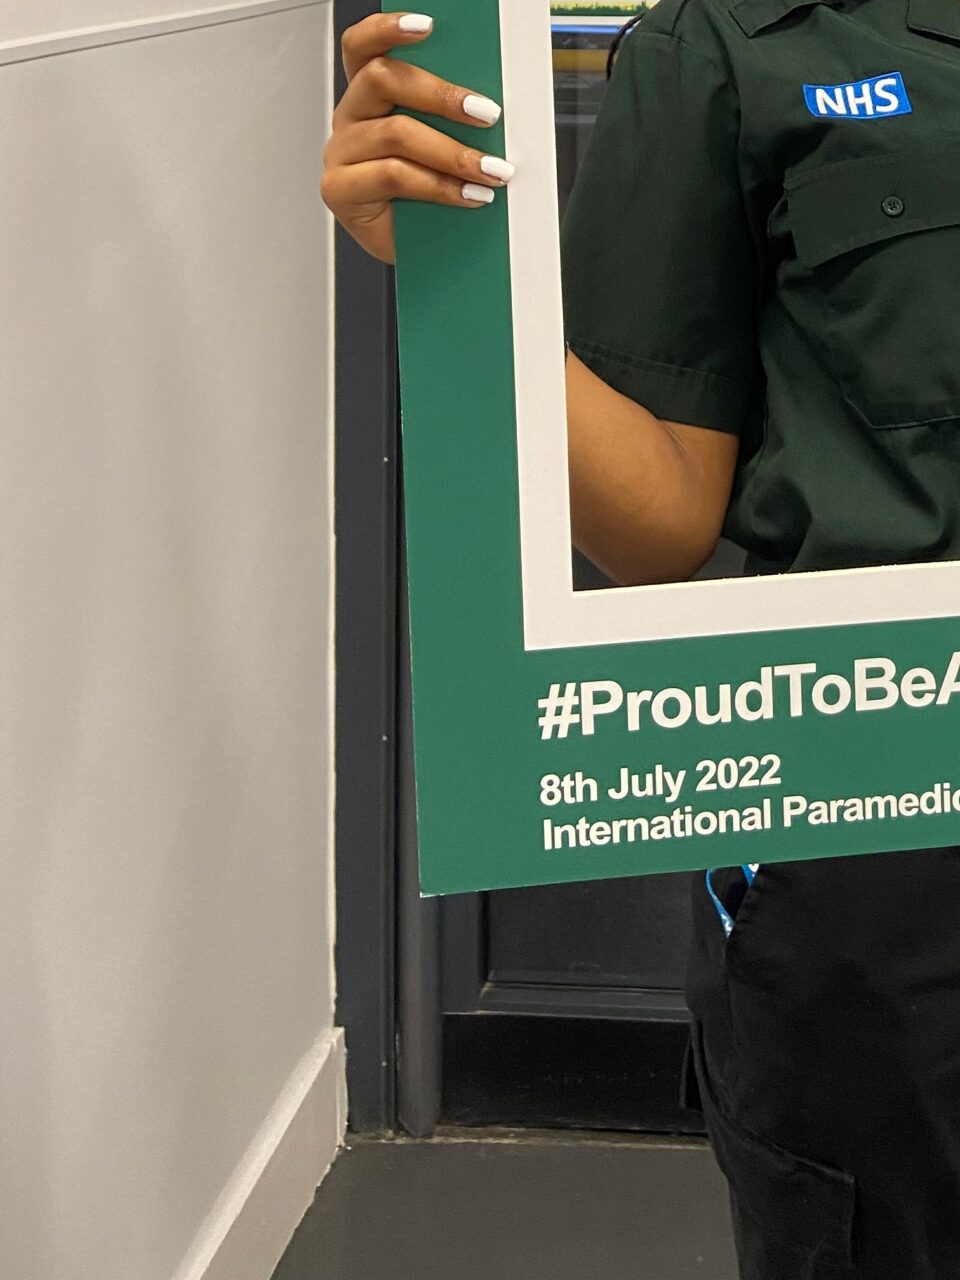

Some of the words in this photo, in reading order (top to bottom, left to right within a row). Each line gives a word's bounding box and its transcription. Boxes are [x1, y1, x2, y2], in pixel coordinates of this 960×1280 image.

[815, 78, 899, 115] NHS
[540, 771, 598, 806] 8th
[607, 764, 687, 803] July
[695, 754, 782, 791] 2022
[543, 798, 772, 850] International
